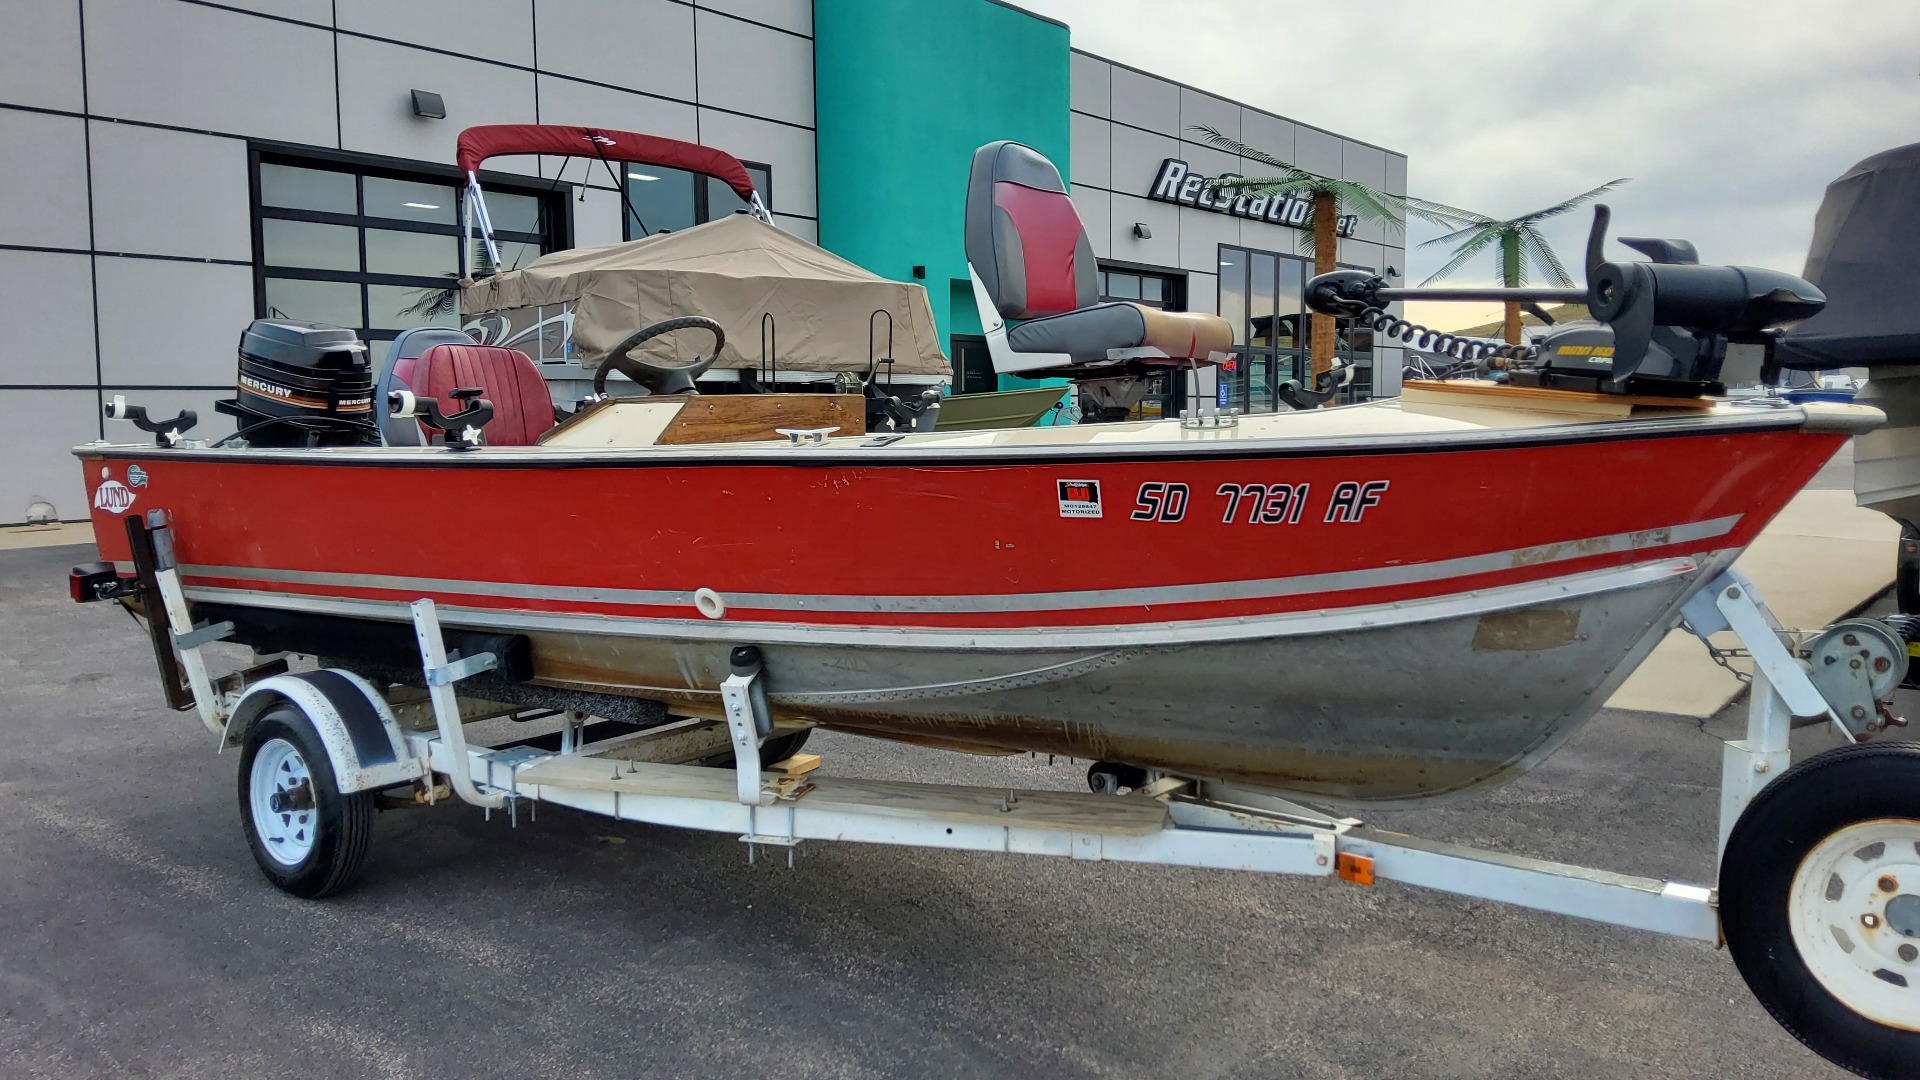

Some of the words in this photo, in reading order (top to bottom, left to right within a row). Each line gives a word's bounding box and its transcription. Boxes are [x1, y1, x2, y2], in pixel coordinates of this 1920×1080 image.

[241, 374, 291, 397] MERCURY
[99, 486, 129, 508] LUND
[1130, 481, 1190, 523] SD
[1216, 483, 1310, 524] 7731
[1323, 480, 1390, 523] AF
